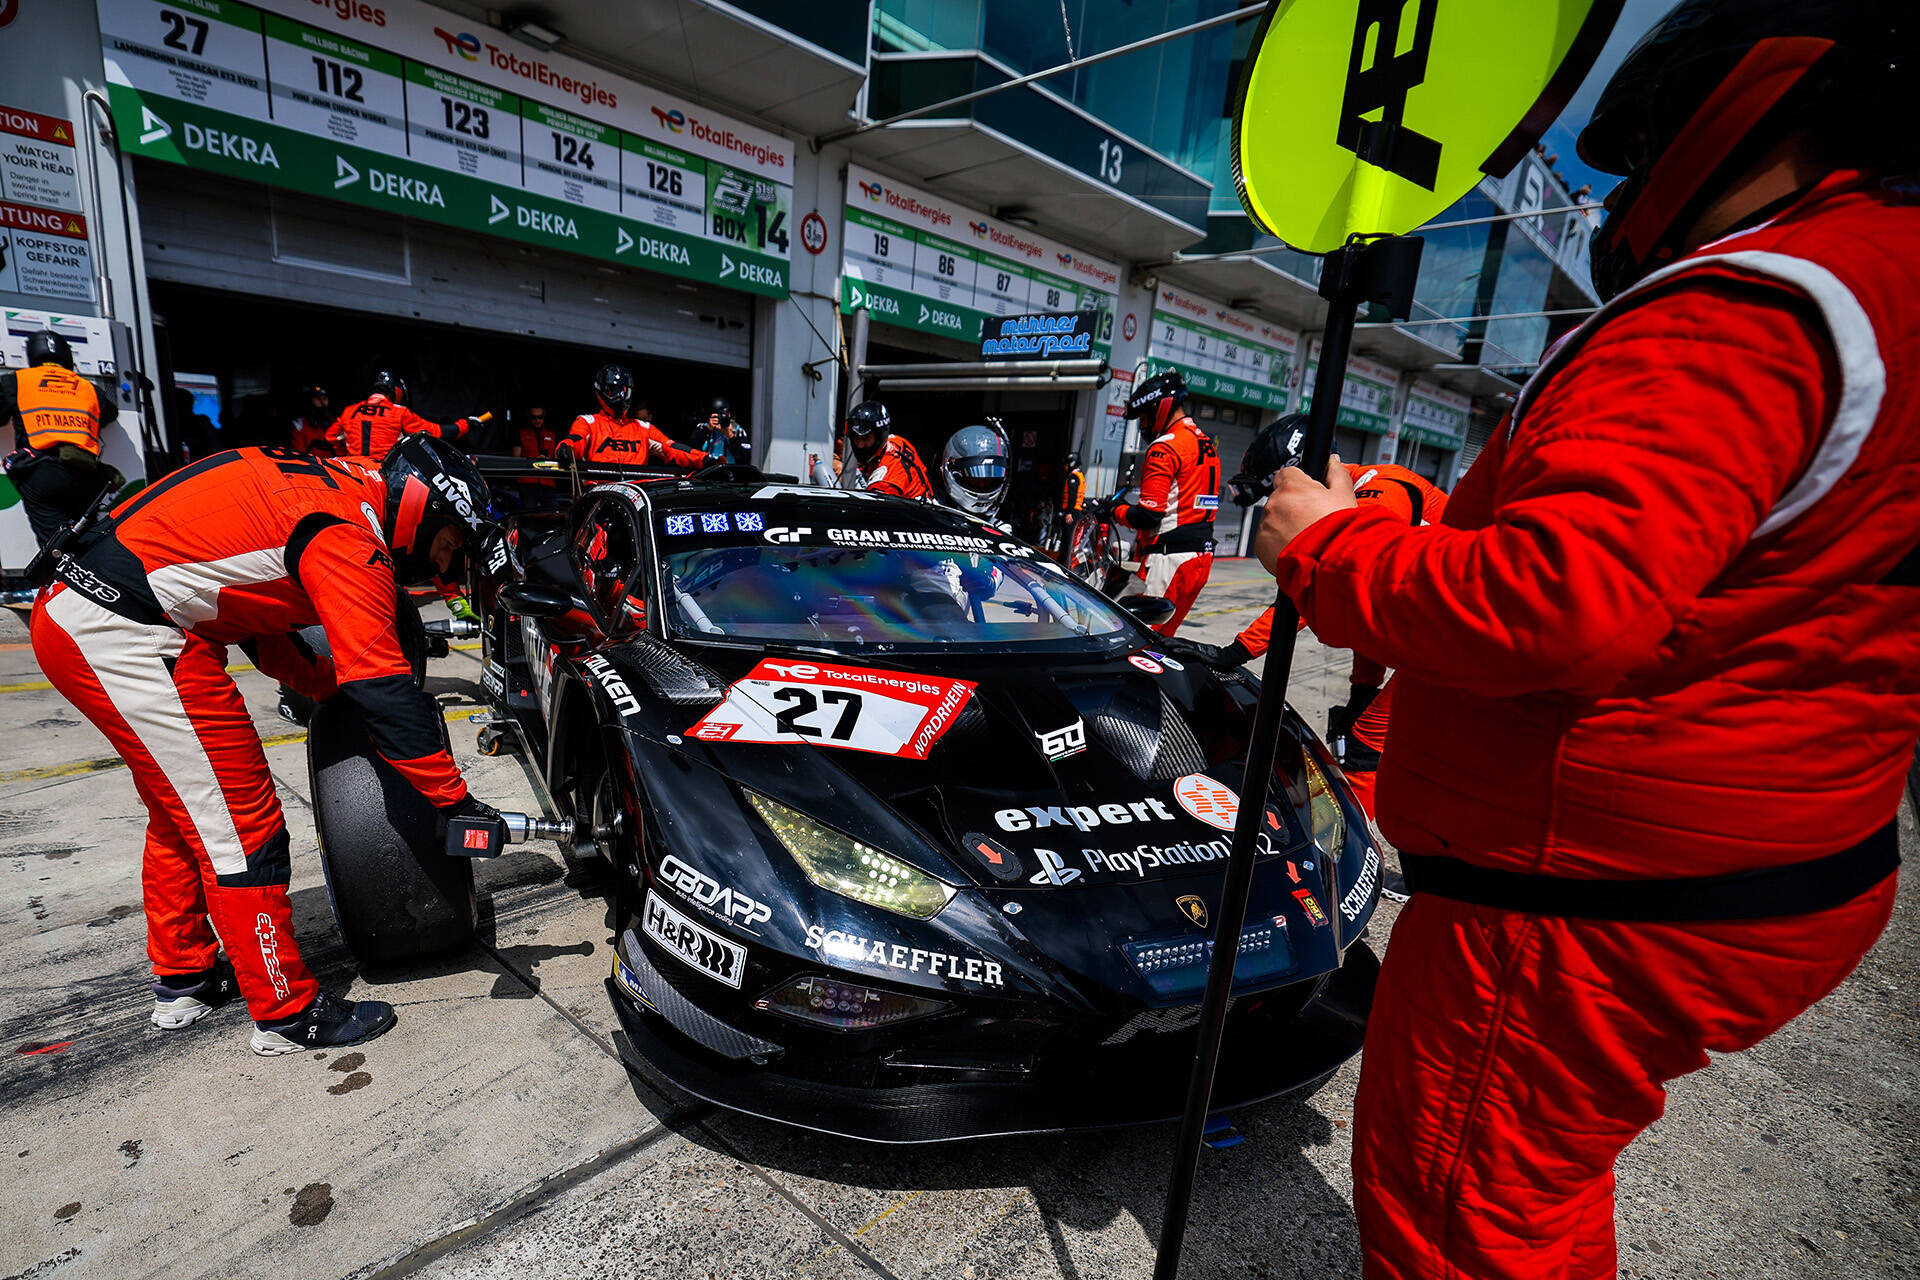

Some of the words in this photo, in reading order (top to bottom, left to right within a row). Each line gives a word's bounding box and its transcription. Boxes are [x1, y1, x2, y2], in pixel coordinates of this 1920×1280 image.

[160, 10, 209, 56] 27
[177, 57, 219, 79] HURACAN
[312, 56, 364, 104] 112
[485, 43, 617, 109] TotalEnergies
[441, 96, 489, 139] 123
[15, 143, 60, 162] WATCH
[184, 122, 280, 169] DEKRA
[551, 131, 594, 170] 124
[688, 117, 785, 168] TotalEnergies
[2, 153, 38, 170] YOUR
[41, 160, 74, 177] HEAD
[1099, 139, 1123, 184] 13
[369, 168, 445, 207] DEKRA
[647, 162, 682, 196] 126
[517, 205, 578, 239] DEKRA
[884, 188, 951, 226] TotalEnergies
[712, 213, 746, 244] BOX
[755, 203, 789, 254] 14
[988, 226, 1044, 258] TotalEnergies
[26, 252, 80, 268] GEFAHR
[639, 236, 690, 266] DEKRA
[874, 233, 889, 257] 19
[740, 262, 783, 288] DEKRA
[939, 254, 955, 276] 86
[1071, 257, 1117, 284] TotalEnergies
[997, 273, 1011, 293] 87
[1046, 288, 1060, 308] 88
[865, 293, 900, 315] DEKRA
[932, 310, 962, 330] DEKRA
[1000, 314, 1078, 336] mühlner
[1165, 326, 1175, 342] 72
[982, 332, 1091, 358] motorsport
[100, 361, 114, 375] 14
[352, 404, 392, 419] ABT
[1131, 388, 1163, 409] uvex
[36, 414, 52, 427] PIT
[596, 437, 642, 453] ABT
[432, 472, 483, 531] uvex
[827, 528, 890, 544] GRAN
[893, 531, 989, 549] TURISMO
[935, 545, 994, 554] SIMULATOR
[822, 670, 941, 696] TotalEnergies
[773, 687, 863, 742] 27
[913, 681, 967, 757] NORDRHEIN
[994, 797, 1176, 833] expert
[1081, 838, 1224, 878] PlayStation
[1340, 847, 1380, 922] SCHAEFFLER
[676, 889, 687, 901] auto
[686, 895, 715, 916] intelligence
[715, 911, 734, 927] coding
[649, 898, 700, 962] H&R
[804, 925, 1004, 986] SCHAEFFLER
